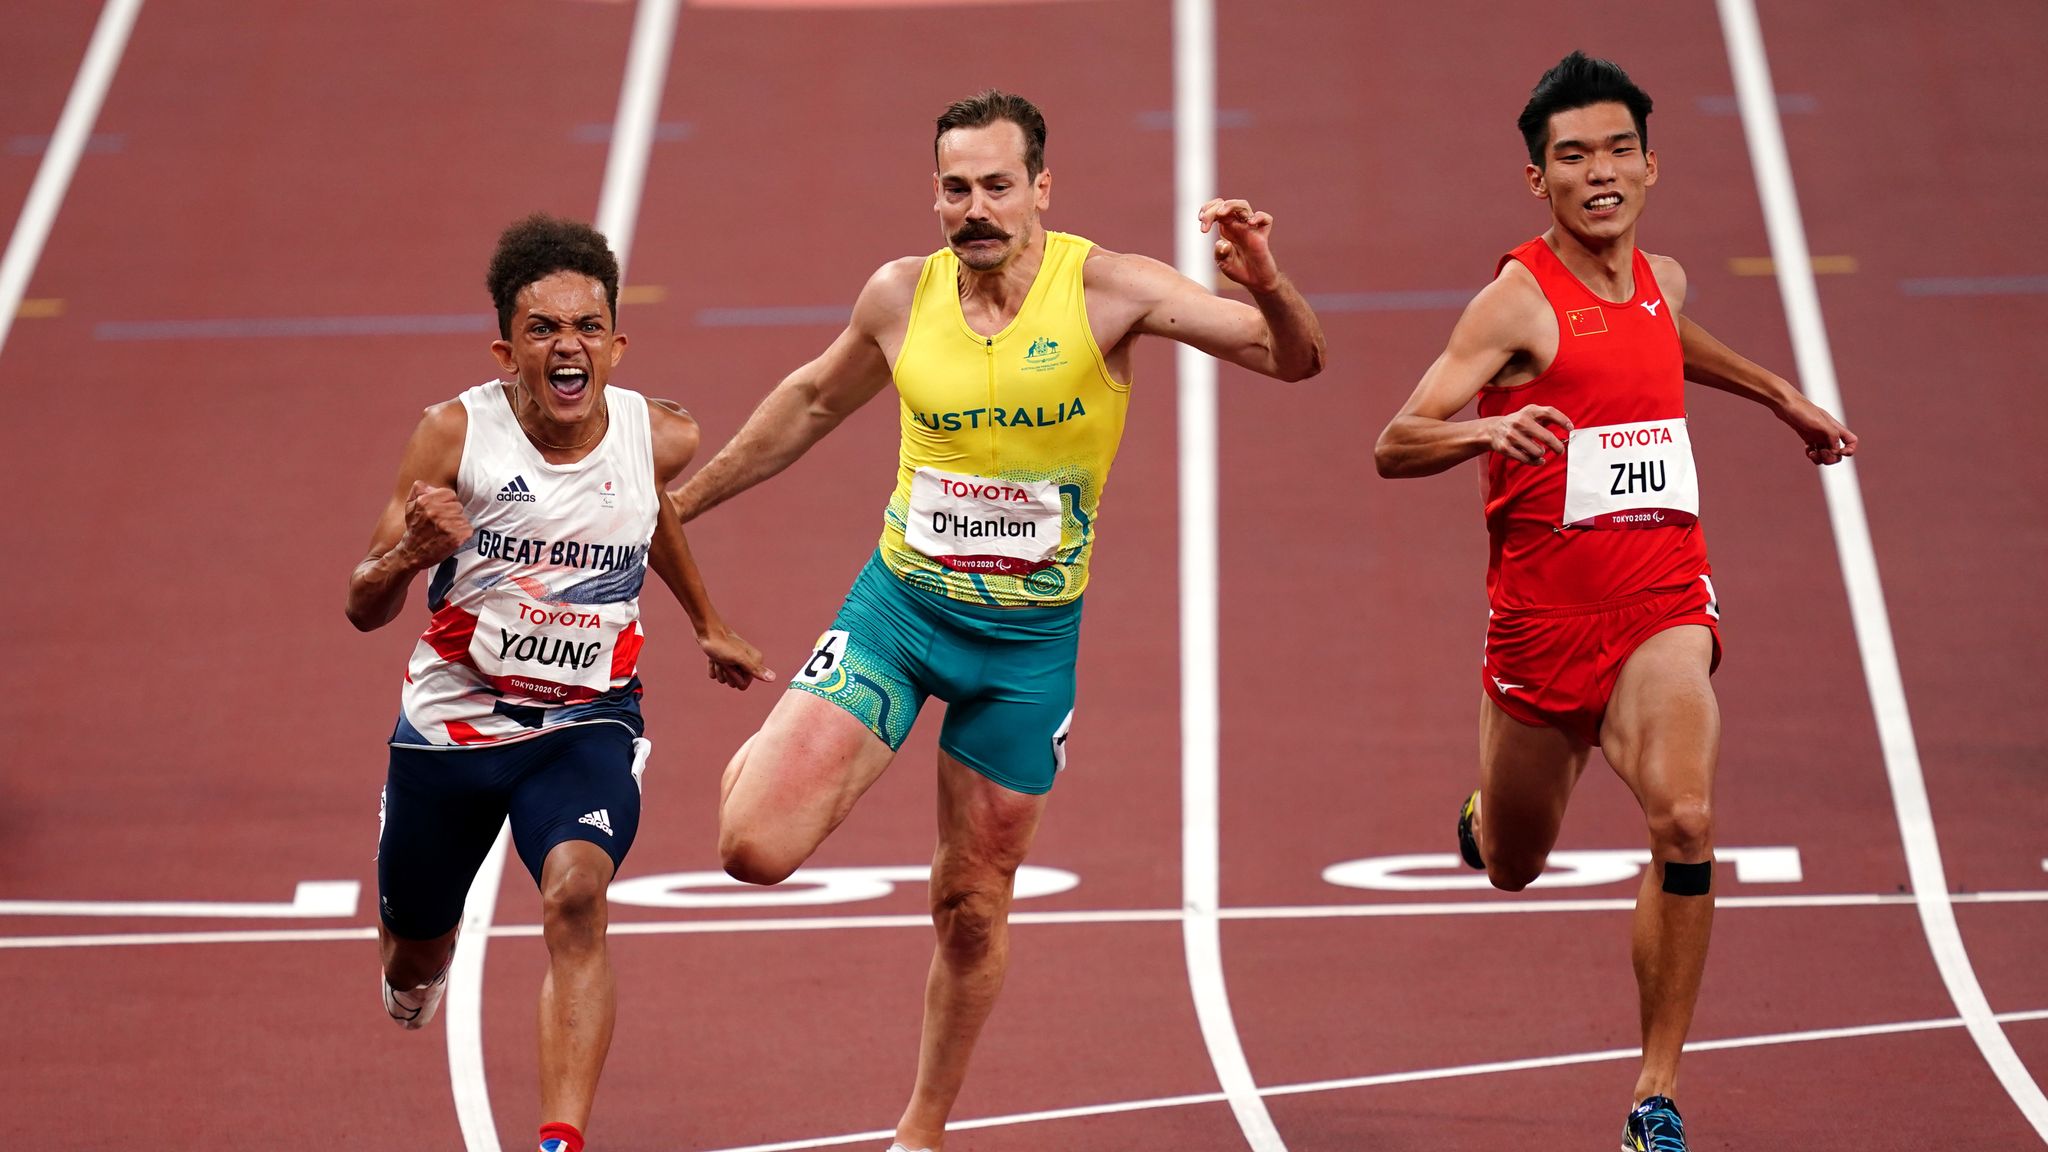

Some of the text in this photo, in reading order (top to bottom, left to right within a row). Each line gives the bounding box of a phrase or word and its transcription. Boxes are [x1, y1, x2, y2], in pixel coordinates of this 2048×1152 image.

[1599, 427, 1673, 449] TOYOTA
[1610, 459, 1666, 495] ZHU
[496, 491, 536, 502] adidas
[940, 478, 1029, 502] TOYOTA
[932, 511, 1036, 538] O'Hanlon
[1612, 513, 1651, 523] TOKYO 2020
[477, 529, 635, 571] GREAT BRITAIN
[953, 559, 994, 568] TOKYO 2020
[518, 602, 601, 628] TOYOTA
[500, 628, 602, 670] YOUNG
[511, 679, 552, 693] TOKYO 2020
[578, 816, 614, 837] adidas
